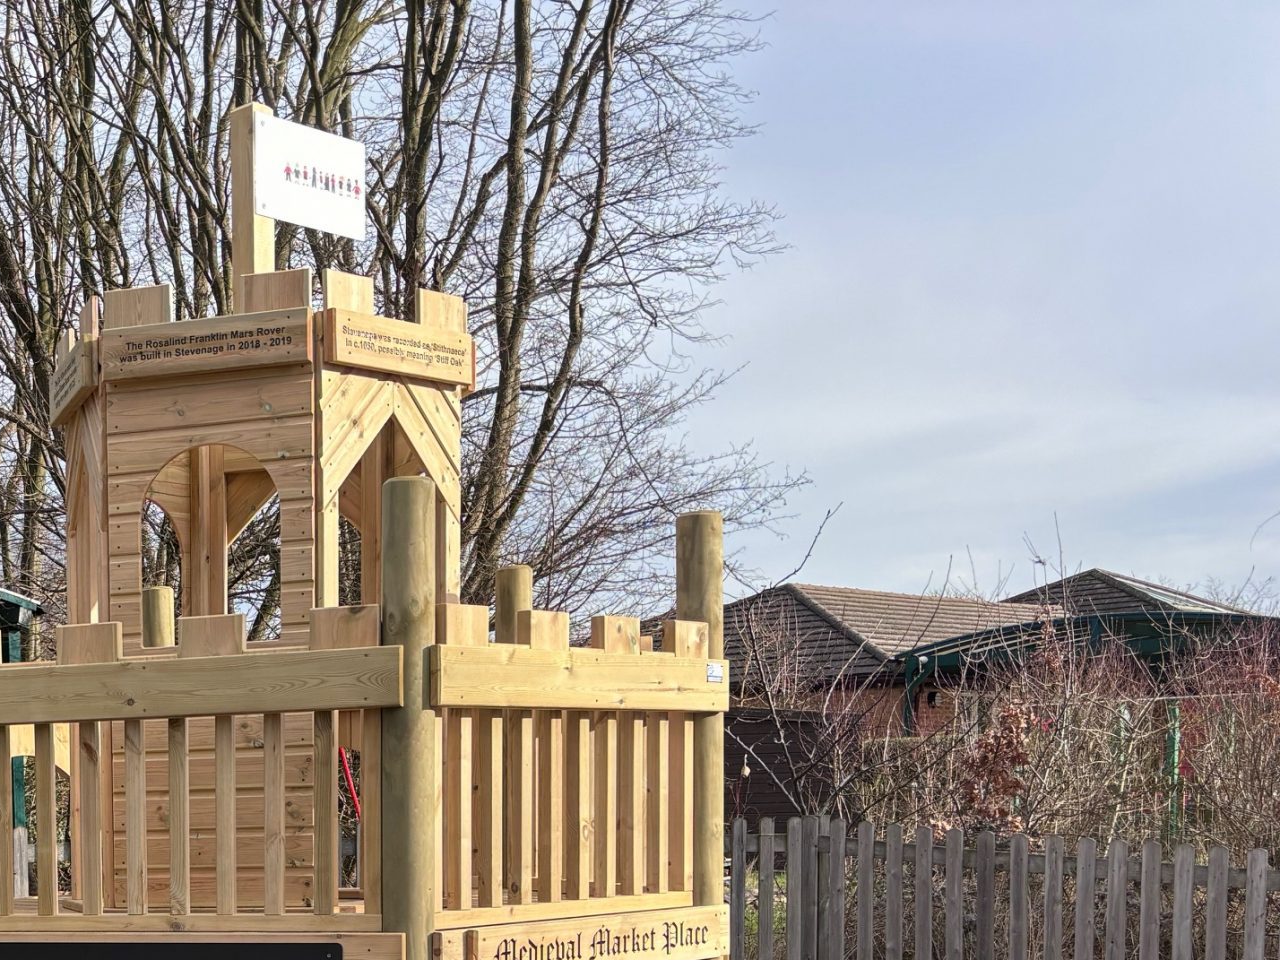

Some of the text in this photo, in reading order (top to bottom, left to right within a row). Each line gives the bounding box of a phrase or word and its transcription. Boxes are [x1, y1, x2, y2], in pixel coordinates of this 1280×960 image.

[119, 354, 138, 364] was
[140, 349, 161, 361] built
[163, 348, 172, 359] in
[174, 345, 224, 357] Stevenage
[226, 342, 236, 352] in
[238, 339, 261, 351] 2018
[270, 336, 292, 347] 2019
[126, 326, 286, 351] The Rosalind Franklin Mars Rover
[588, 926, 657, 960] Market
[661, 921, 709, 955] Place
